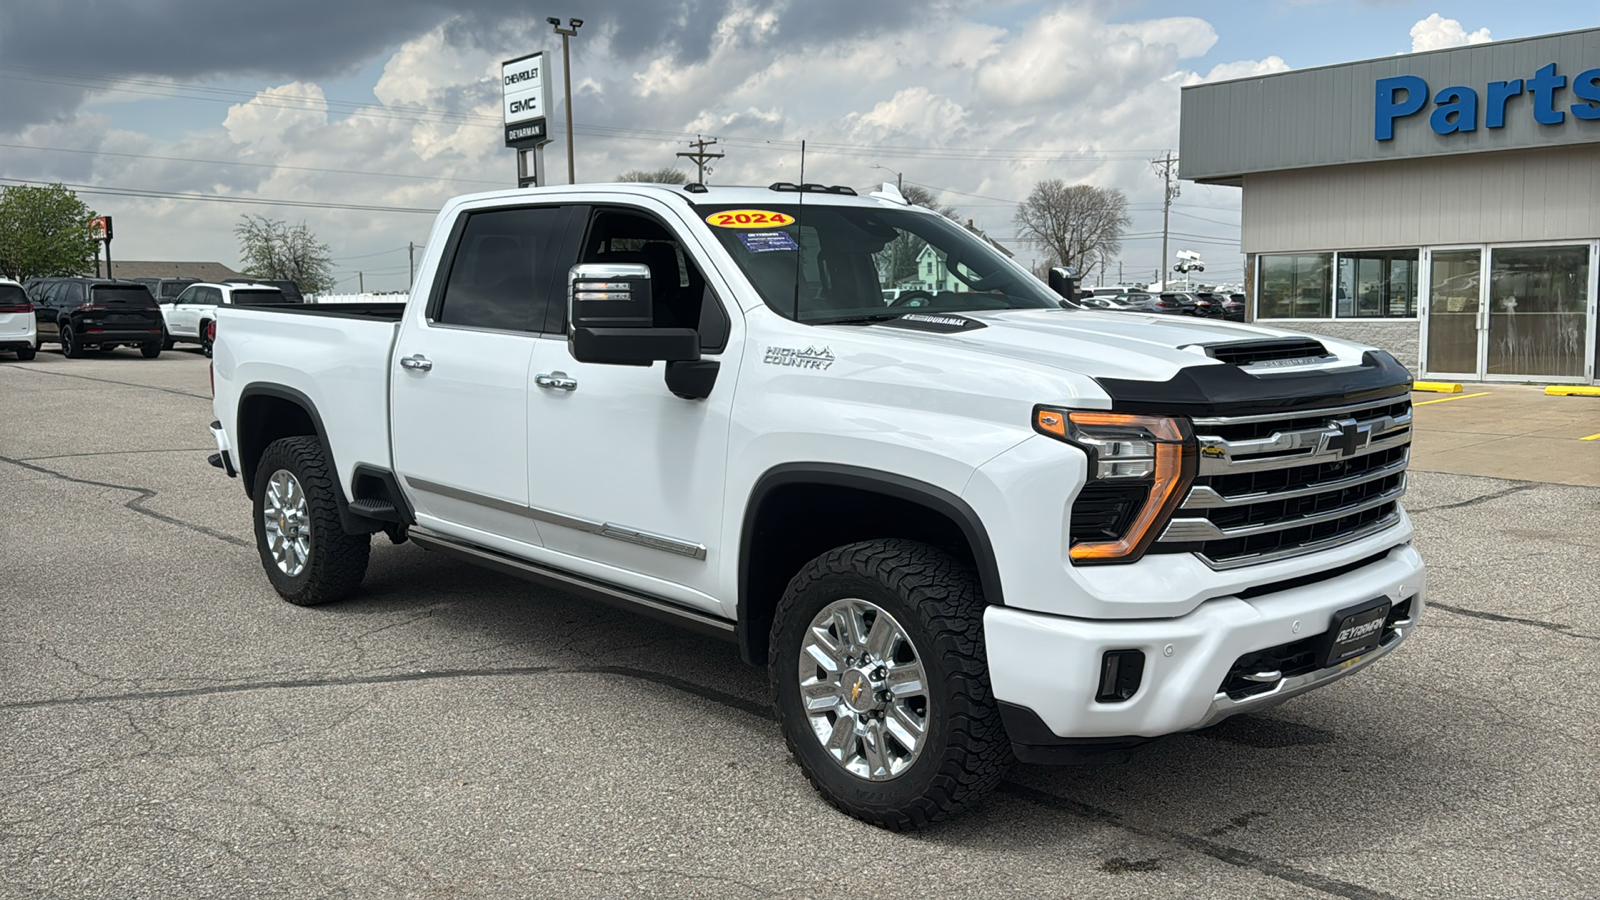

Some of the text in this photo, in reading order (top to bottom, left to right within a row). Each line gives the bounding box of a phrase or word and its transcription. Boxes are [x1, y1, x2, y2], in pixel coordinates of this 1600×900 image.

[505, 67, 539, 86] CHEVROLET
[509, 97, 537, 114] GMC
[1375, 62, 1600, 141] Parts
[508, 125, 540, 140] DEYARMAN
[717, 213, 787, 226] 2024
[926, 316, 967, 327] DURAMAX
[766, 346, 801, 357] HIGH
[763, 355, 833, 371] COUNTRY
[1336, 616, 1386, 642] DEYARMAN
